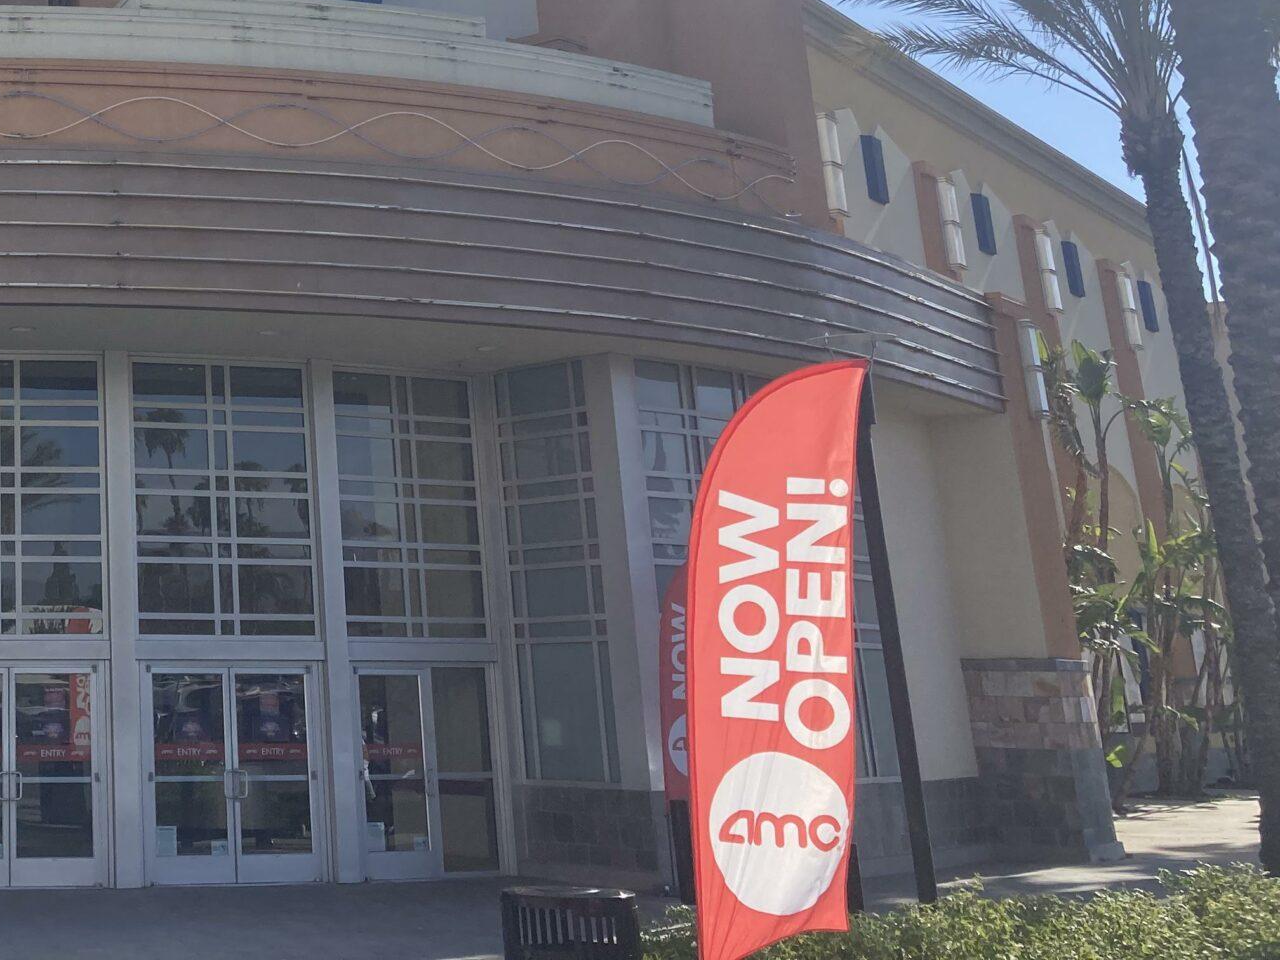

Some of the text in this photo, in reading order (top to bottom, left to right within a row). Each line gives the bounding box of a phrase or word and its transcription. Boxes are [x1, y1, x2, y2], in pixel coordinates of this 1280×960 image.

[718, 489, 780, 722] NOW
[783, 476, 851, 750] OPEN!
[40, 749, 66, 758] ENTRY
[177, 747, 201, 756] ENTRY
[261, 747, 284, 756] ENTRY
[718, 808, 841, 852] amc
